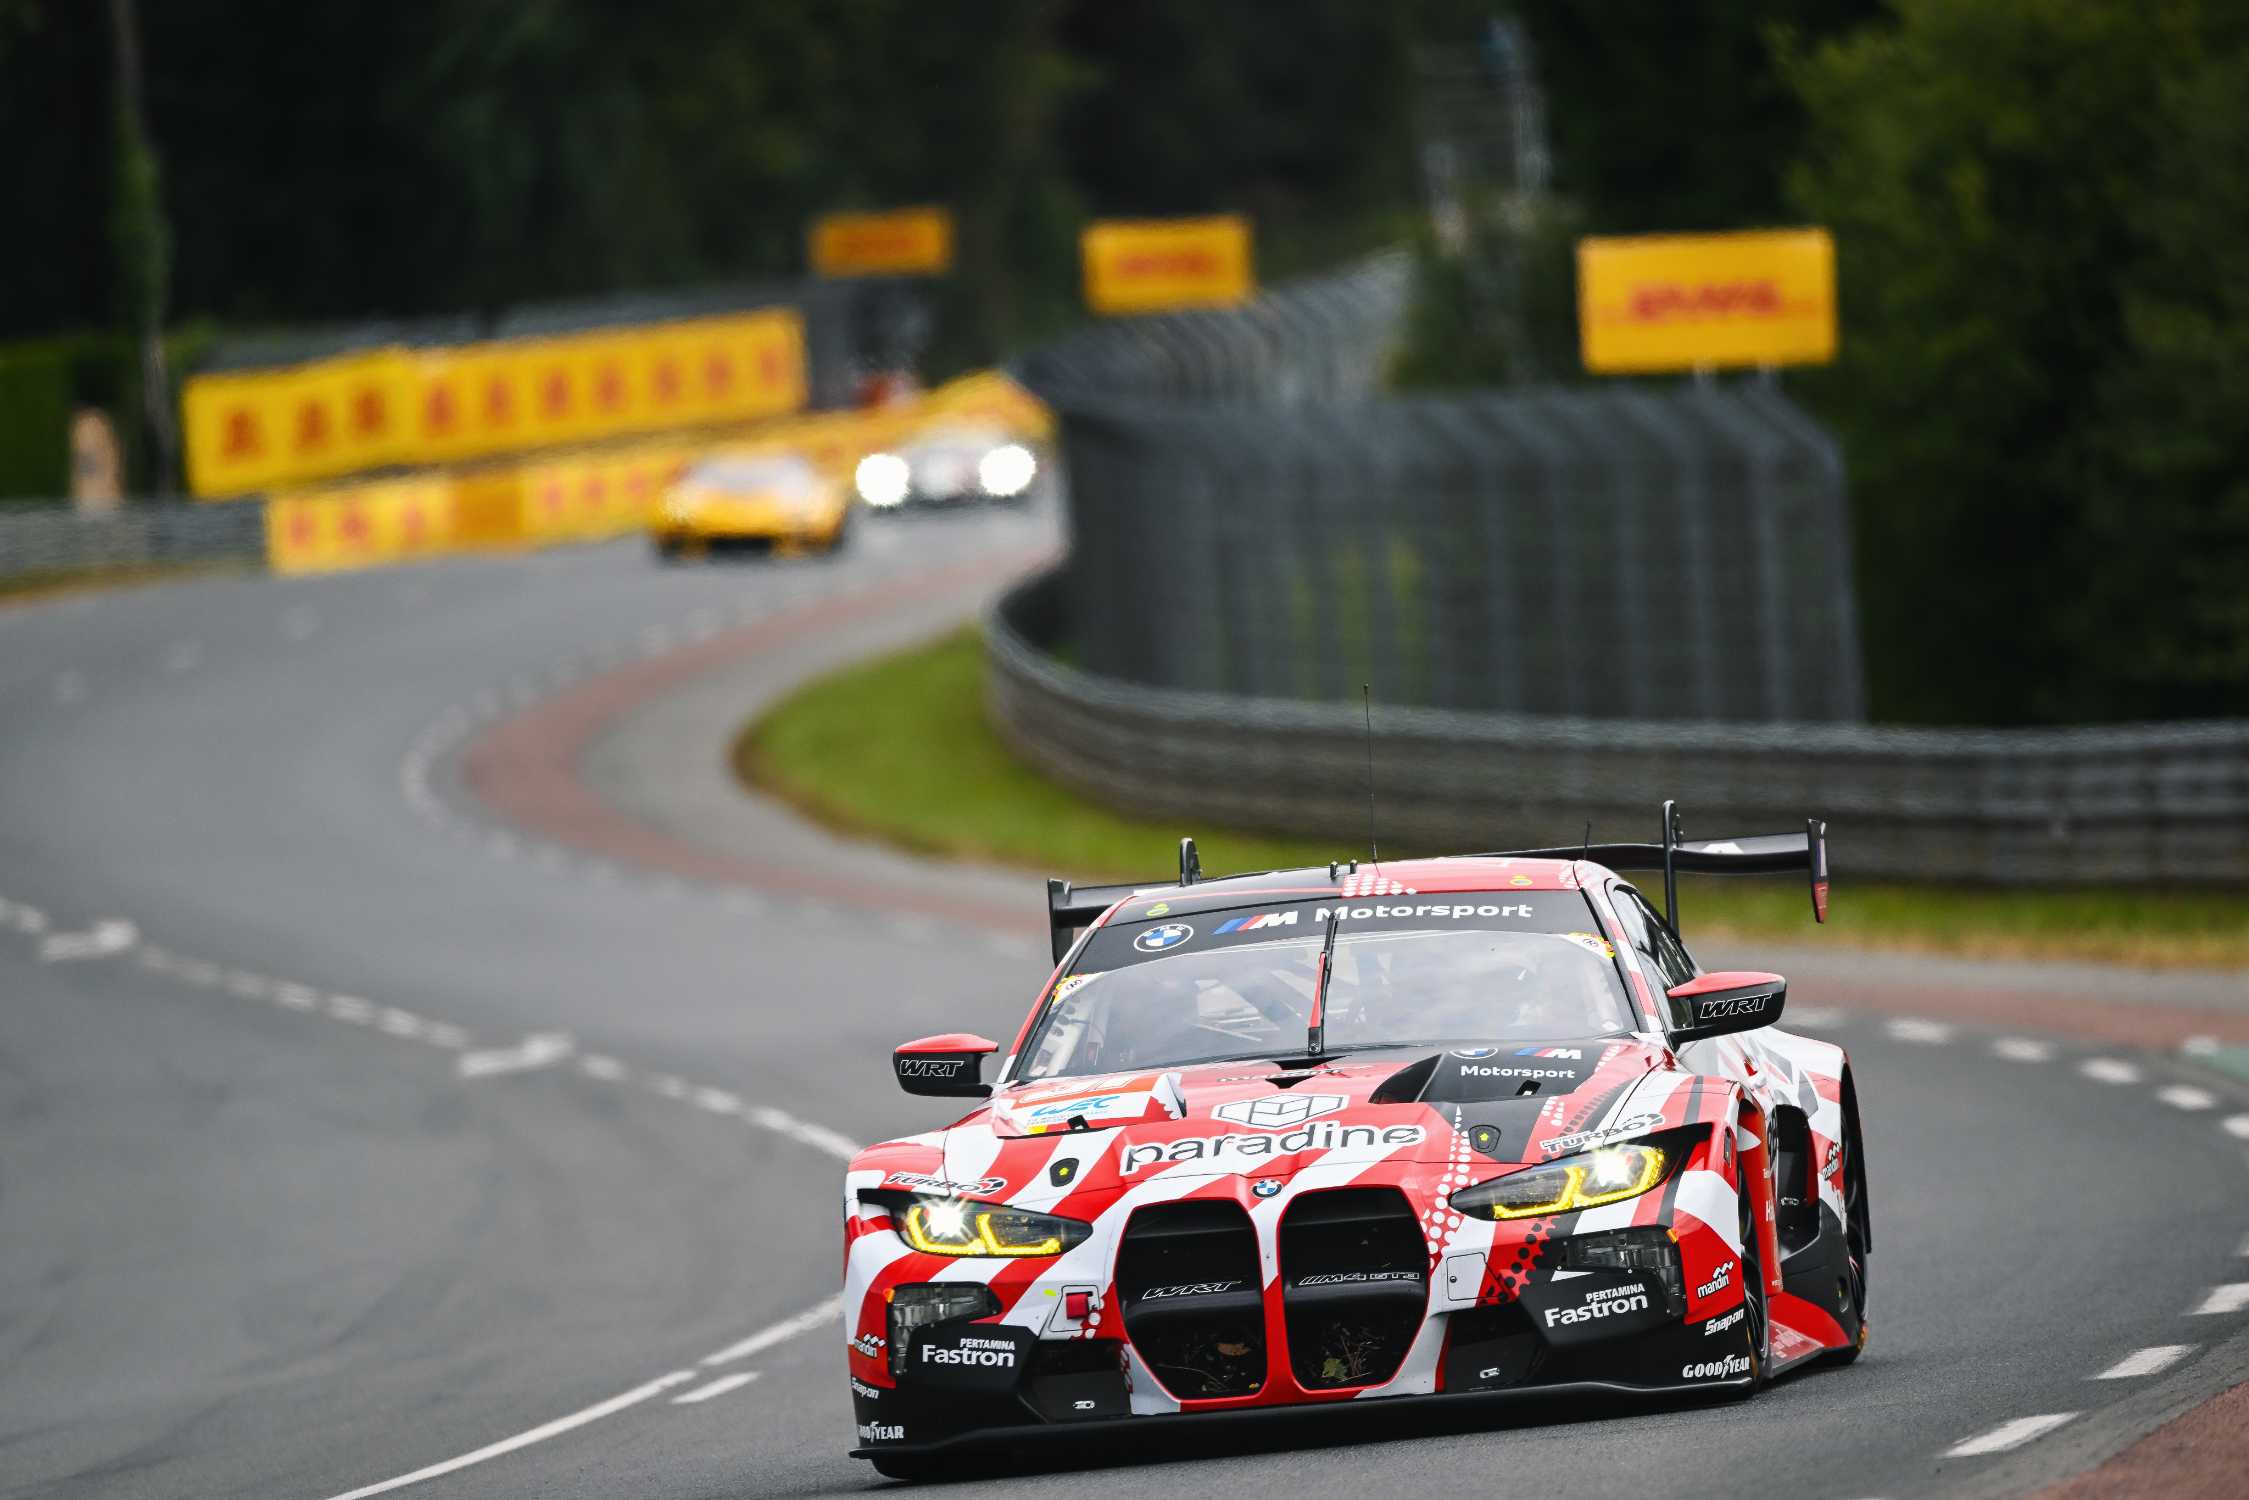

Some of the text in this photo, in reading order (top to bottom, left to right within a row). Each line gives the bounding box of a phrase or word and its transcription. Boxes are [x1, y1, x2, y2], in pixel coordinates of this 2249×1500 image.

[1314, 903, 1533, 922] Motorsport
[1700, 993, 1773, 1019] WRT
[900, 1059, 965, 1078] WRT
[1460, 1065, 1576, 1079] Motorsport
[1126, 1122, 1420, 1172] paradine
[1142, 1280, 1242, 1300] WRT
[1585, 1283, 1646, 1303] PERTAMINA
[1544, 1295, 1649, 1328] Fastron
[960, 1338, 1016, 1350] PERTAMINA
[922, 1344, 1015, 1367] Fastron
[1682, 1356, 1750, 1378] GOODYEAR
